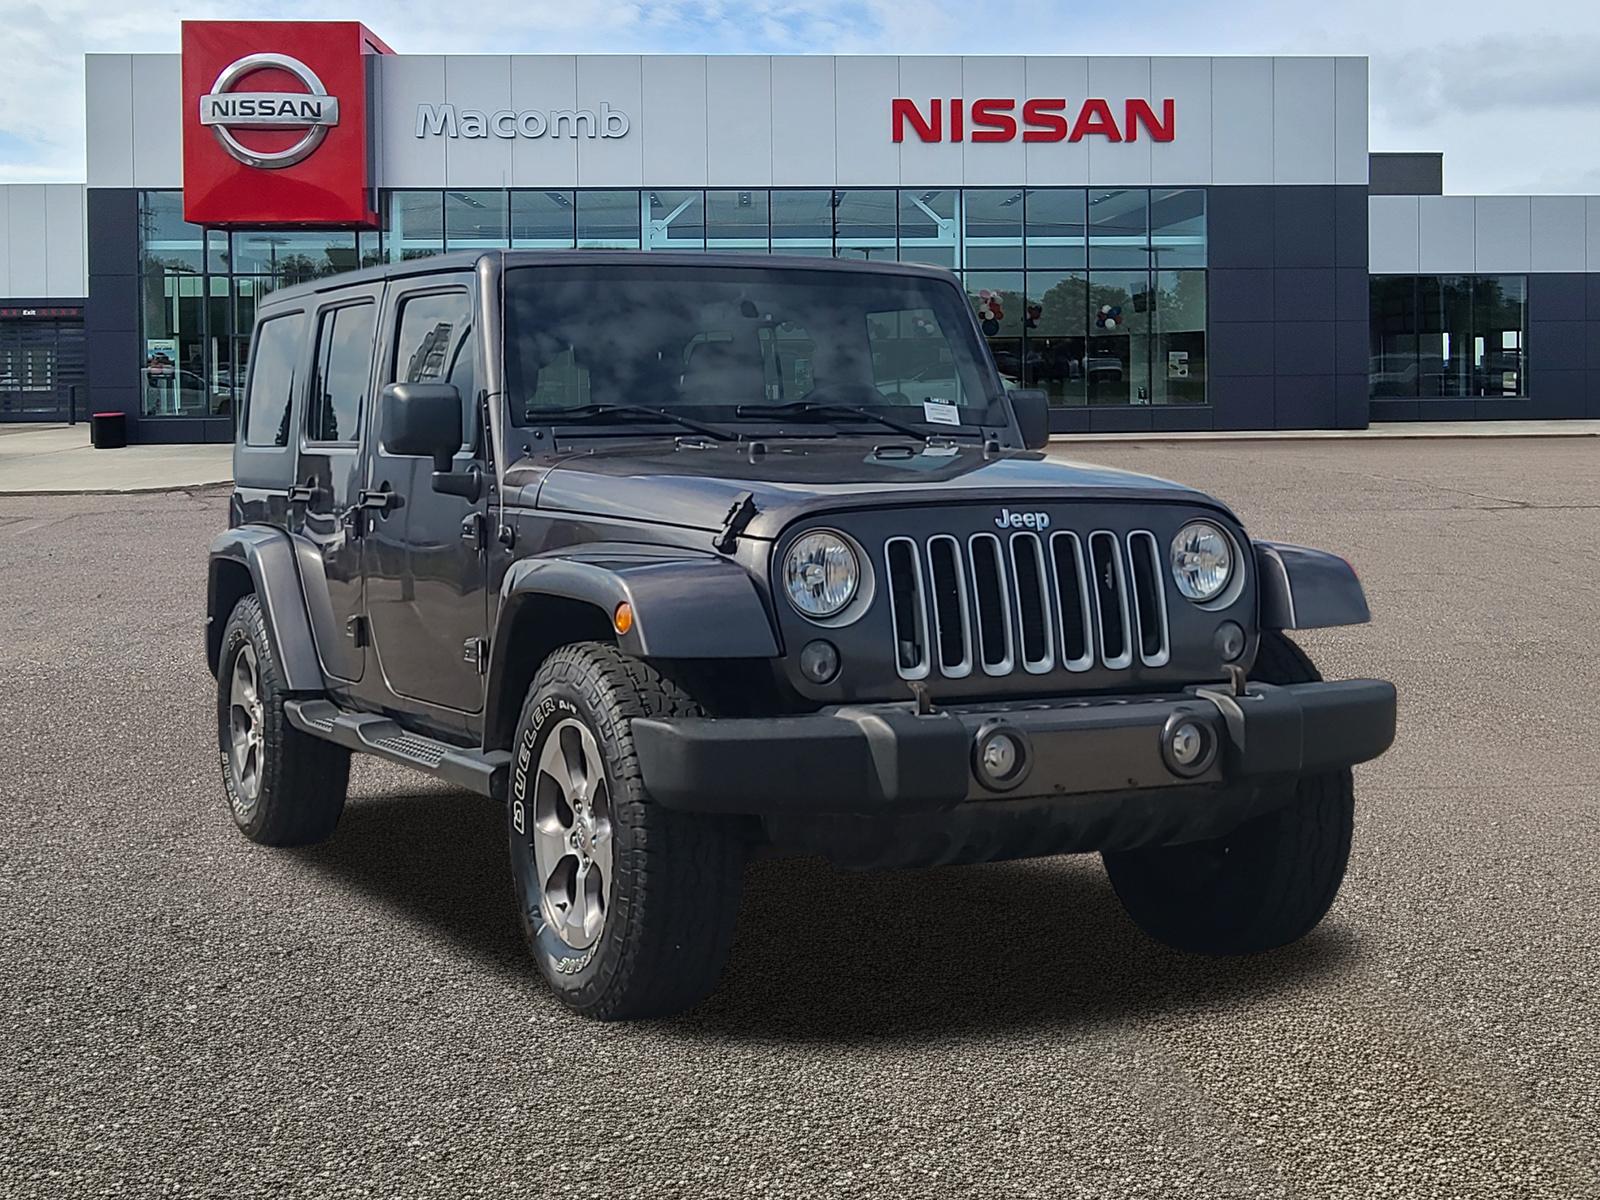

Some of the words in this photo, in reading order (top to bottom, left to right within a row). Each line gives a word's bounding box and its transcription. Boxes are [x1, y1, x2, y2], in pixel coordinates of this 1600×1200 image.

[212, 100, 322, 117] NISSAN
[415, 102, 630, 138] Macomb
[892, 98, 1175, 142] NISSAN
[995, 508, 1050, 531] Jeep
[513, 697, 556, 834] DUELER
